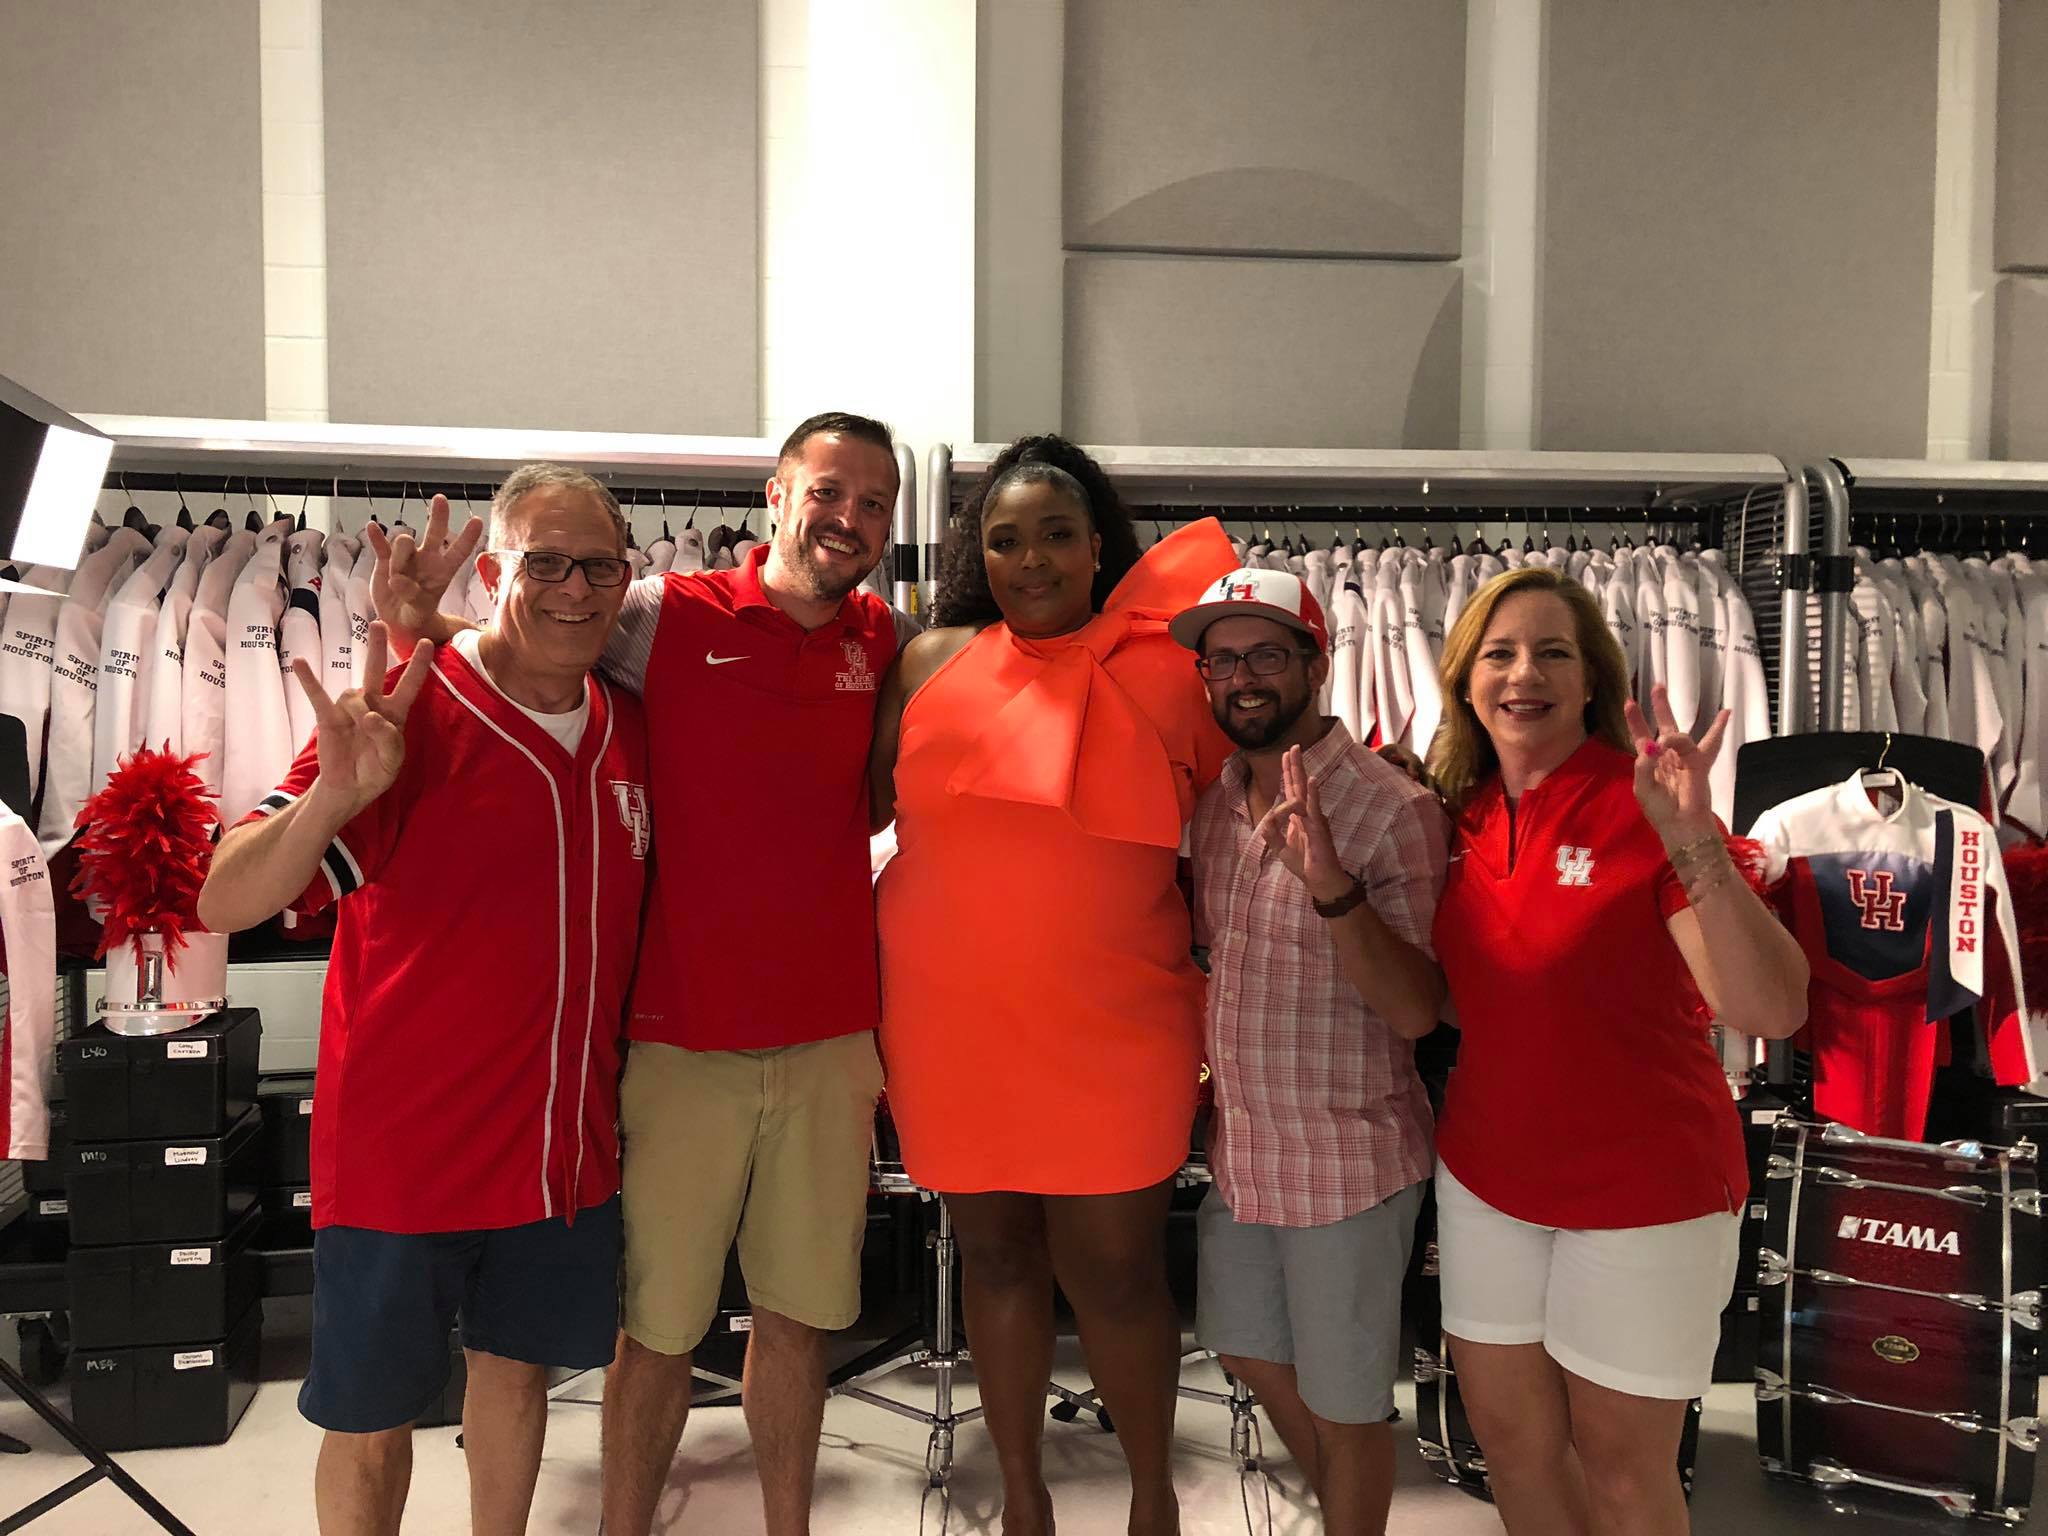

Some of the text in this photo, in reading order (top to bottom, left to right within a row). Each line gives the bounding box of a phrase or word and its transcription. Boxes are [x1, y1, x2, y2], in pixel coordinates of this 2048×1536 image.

[246, 625, 274, 633] SPIRI
[356, 625, 368, 635] OF
[15, 630, 55, 649] SPIRIT
[25, 642, 40, 651] OF
[115, 658, 129, 667] OF
[54, 665, 98, 691] HOUSTO
[75, 667, 90, 678] OF
[104, 665, 137, 680] HOUSTO
[200, 670, 226, 688] HOUS
[11, 855, 36, 869] SPIRIT
[1554, 844, 1596, 886] UH
[19, 866, 29, 875] OF
[1956, 831, 1980, 953] HOUSTON
[1847, 868, 1906, 932] UH
[82, 1046, 108, 1059] L40
[1855, 1218, 1961, 1256] TAMA
